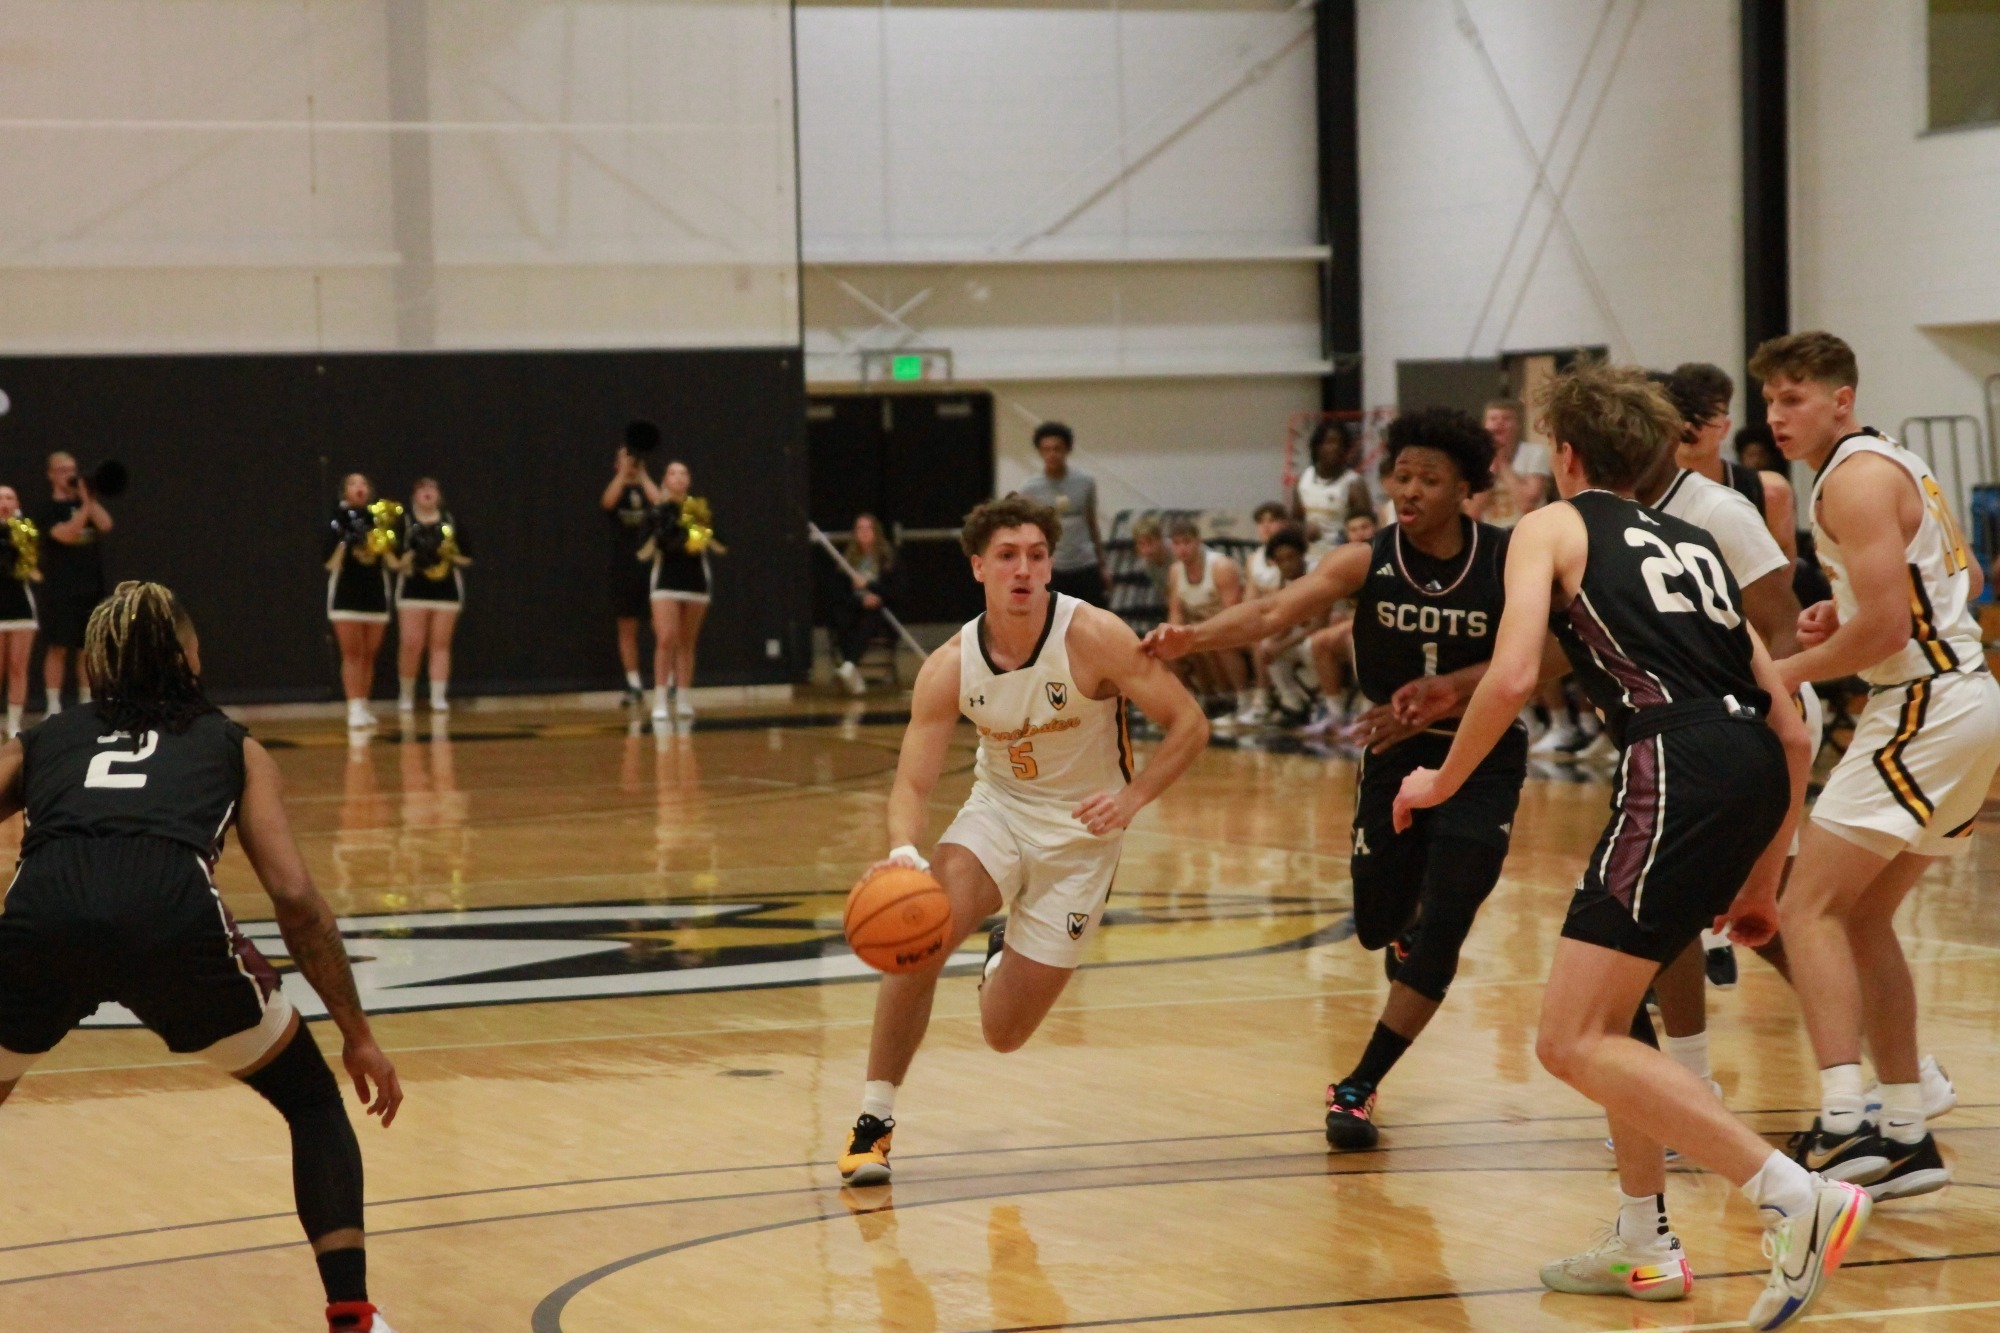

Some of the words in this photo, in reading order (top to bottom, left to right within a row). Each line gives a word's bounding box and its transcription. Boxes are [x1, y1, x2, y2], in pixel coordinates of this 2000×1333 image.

[1624, 527, 1741, 630] 20
[1377, 600, 1488, 638] SCOTS
[1422, 642, 1438, 677] 1
[84, 730, 159, 789] 2
[1008, 741, 1038, 780] 5
